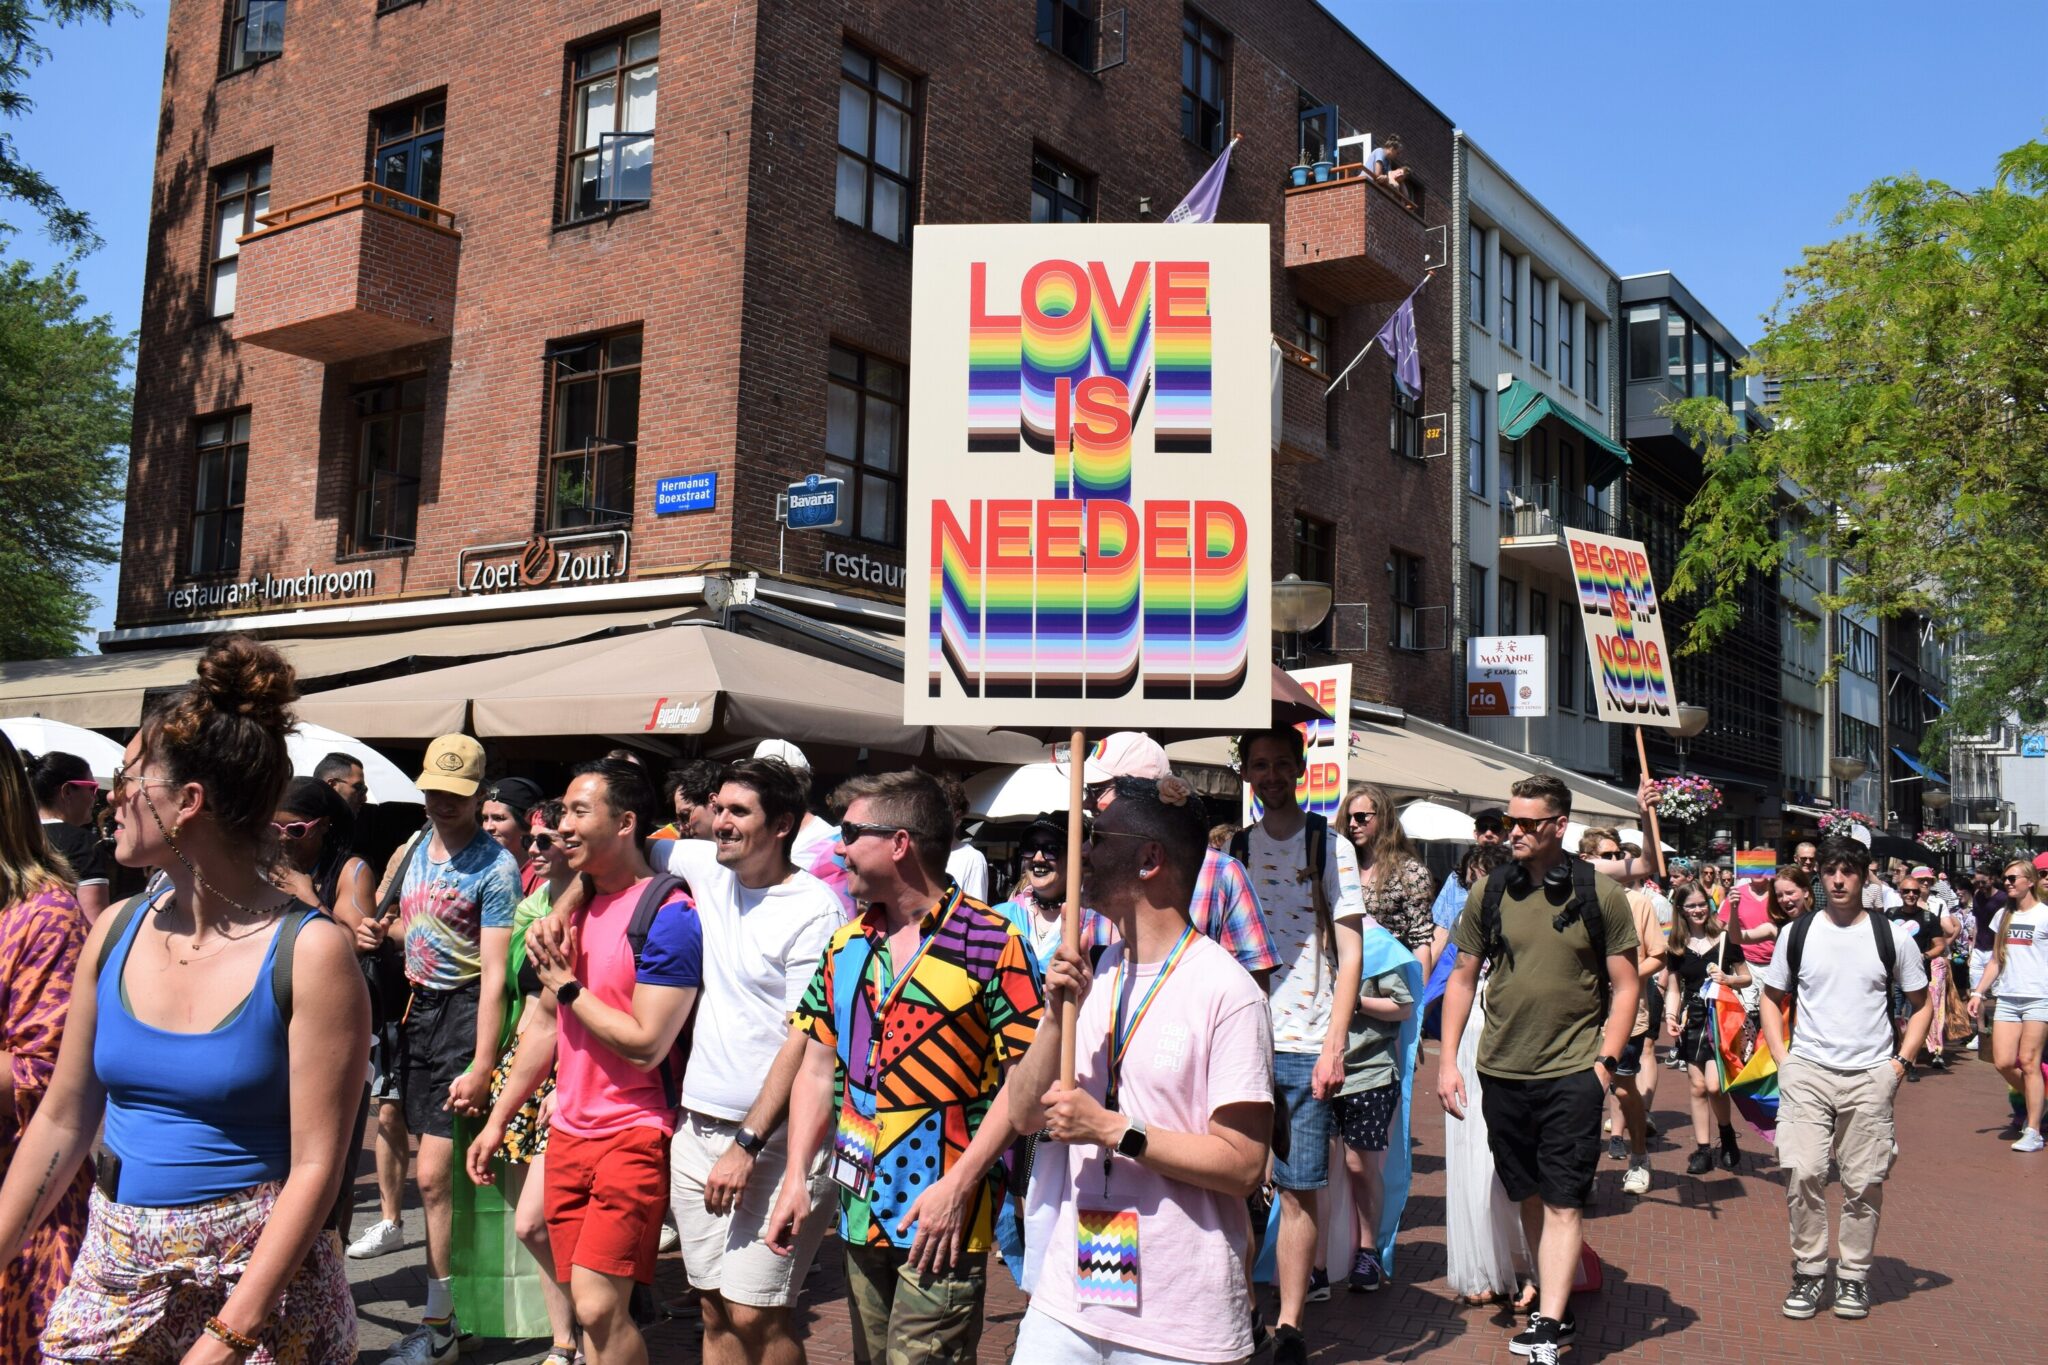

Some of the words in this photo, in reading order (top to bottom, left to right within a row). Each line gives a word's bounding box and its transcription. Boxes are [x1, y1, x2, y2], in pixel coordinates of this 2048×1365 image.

[970, 259, 1212, 328] LOVE
[1055, 376, 1132, 444] IS
[659, 488, 711, 504] Boexstraat
[661, 478, 710, 492] Hermanus
[790, 491, 834, 509] Bavaria
[931, 499, 1248, 570] NEEDED
[470, 559, 519, 591] Zoet
[557, 550, 612, 582] Zout
[824, 549, 907, 589] restaur
[167, 567, 373, 609] restaurant-lunchroom
[1480, 654, 1502, 665] MAY
[1505, 654, 1534, 665] ANNE
[1494, 668, 1528, 676] KAPSALON
[1471, 687, 1497, 705] ria
[644, 697, 700, 731] Segafredo
